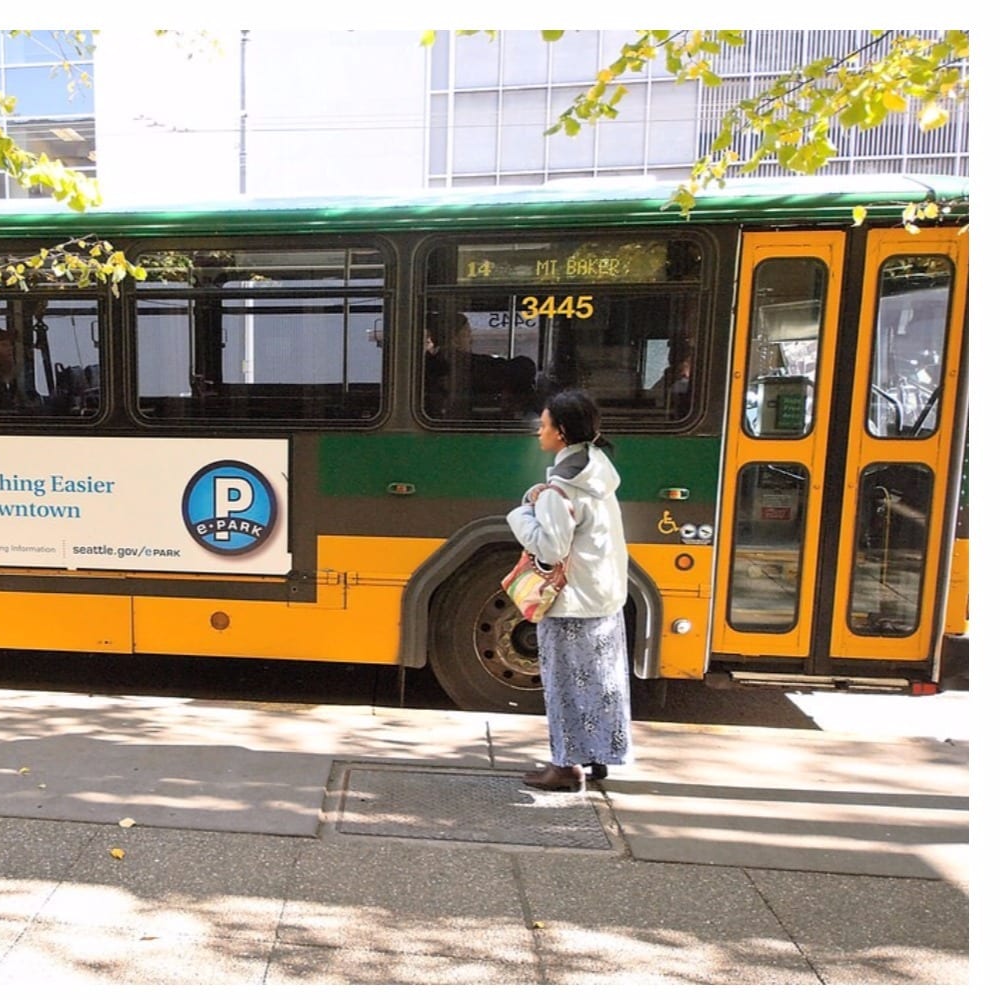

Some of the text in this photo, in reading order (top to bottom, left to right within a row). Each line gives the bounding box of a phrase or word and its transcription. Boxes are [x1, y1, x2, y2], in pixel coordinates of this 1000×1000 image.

[467, 260, 493, 277] 14
[566, 258, 620, 276] BAKER
[521, 295, 594, 319] 3445
[50, 475, 116, 494] Easier
[10, 545, 57, 554] Information
